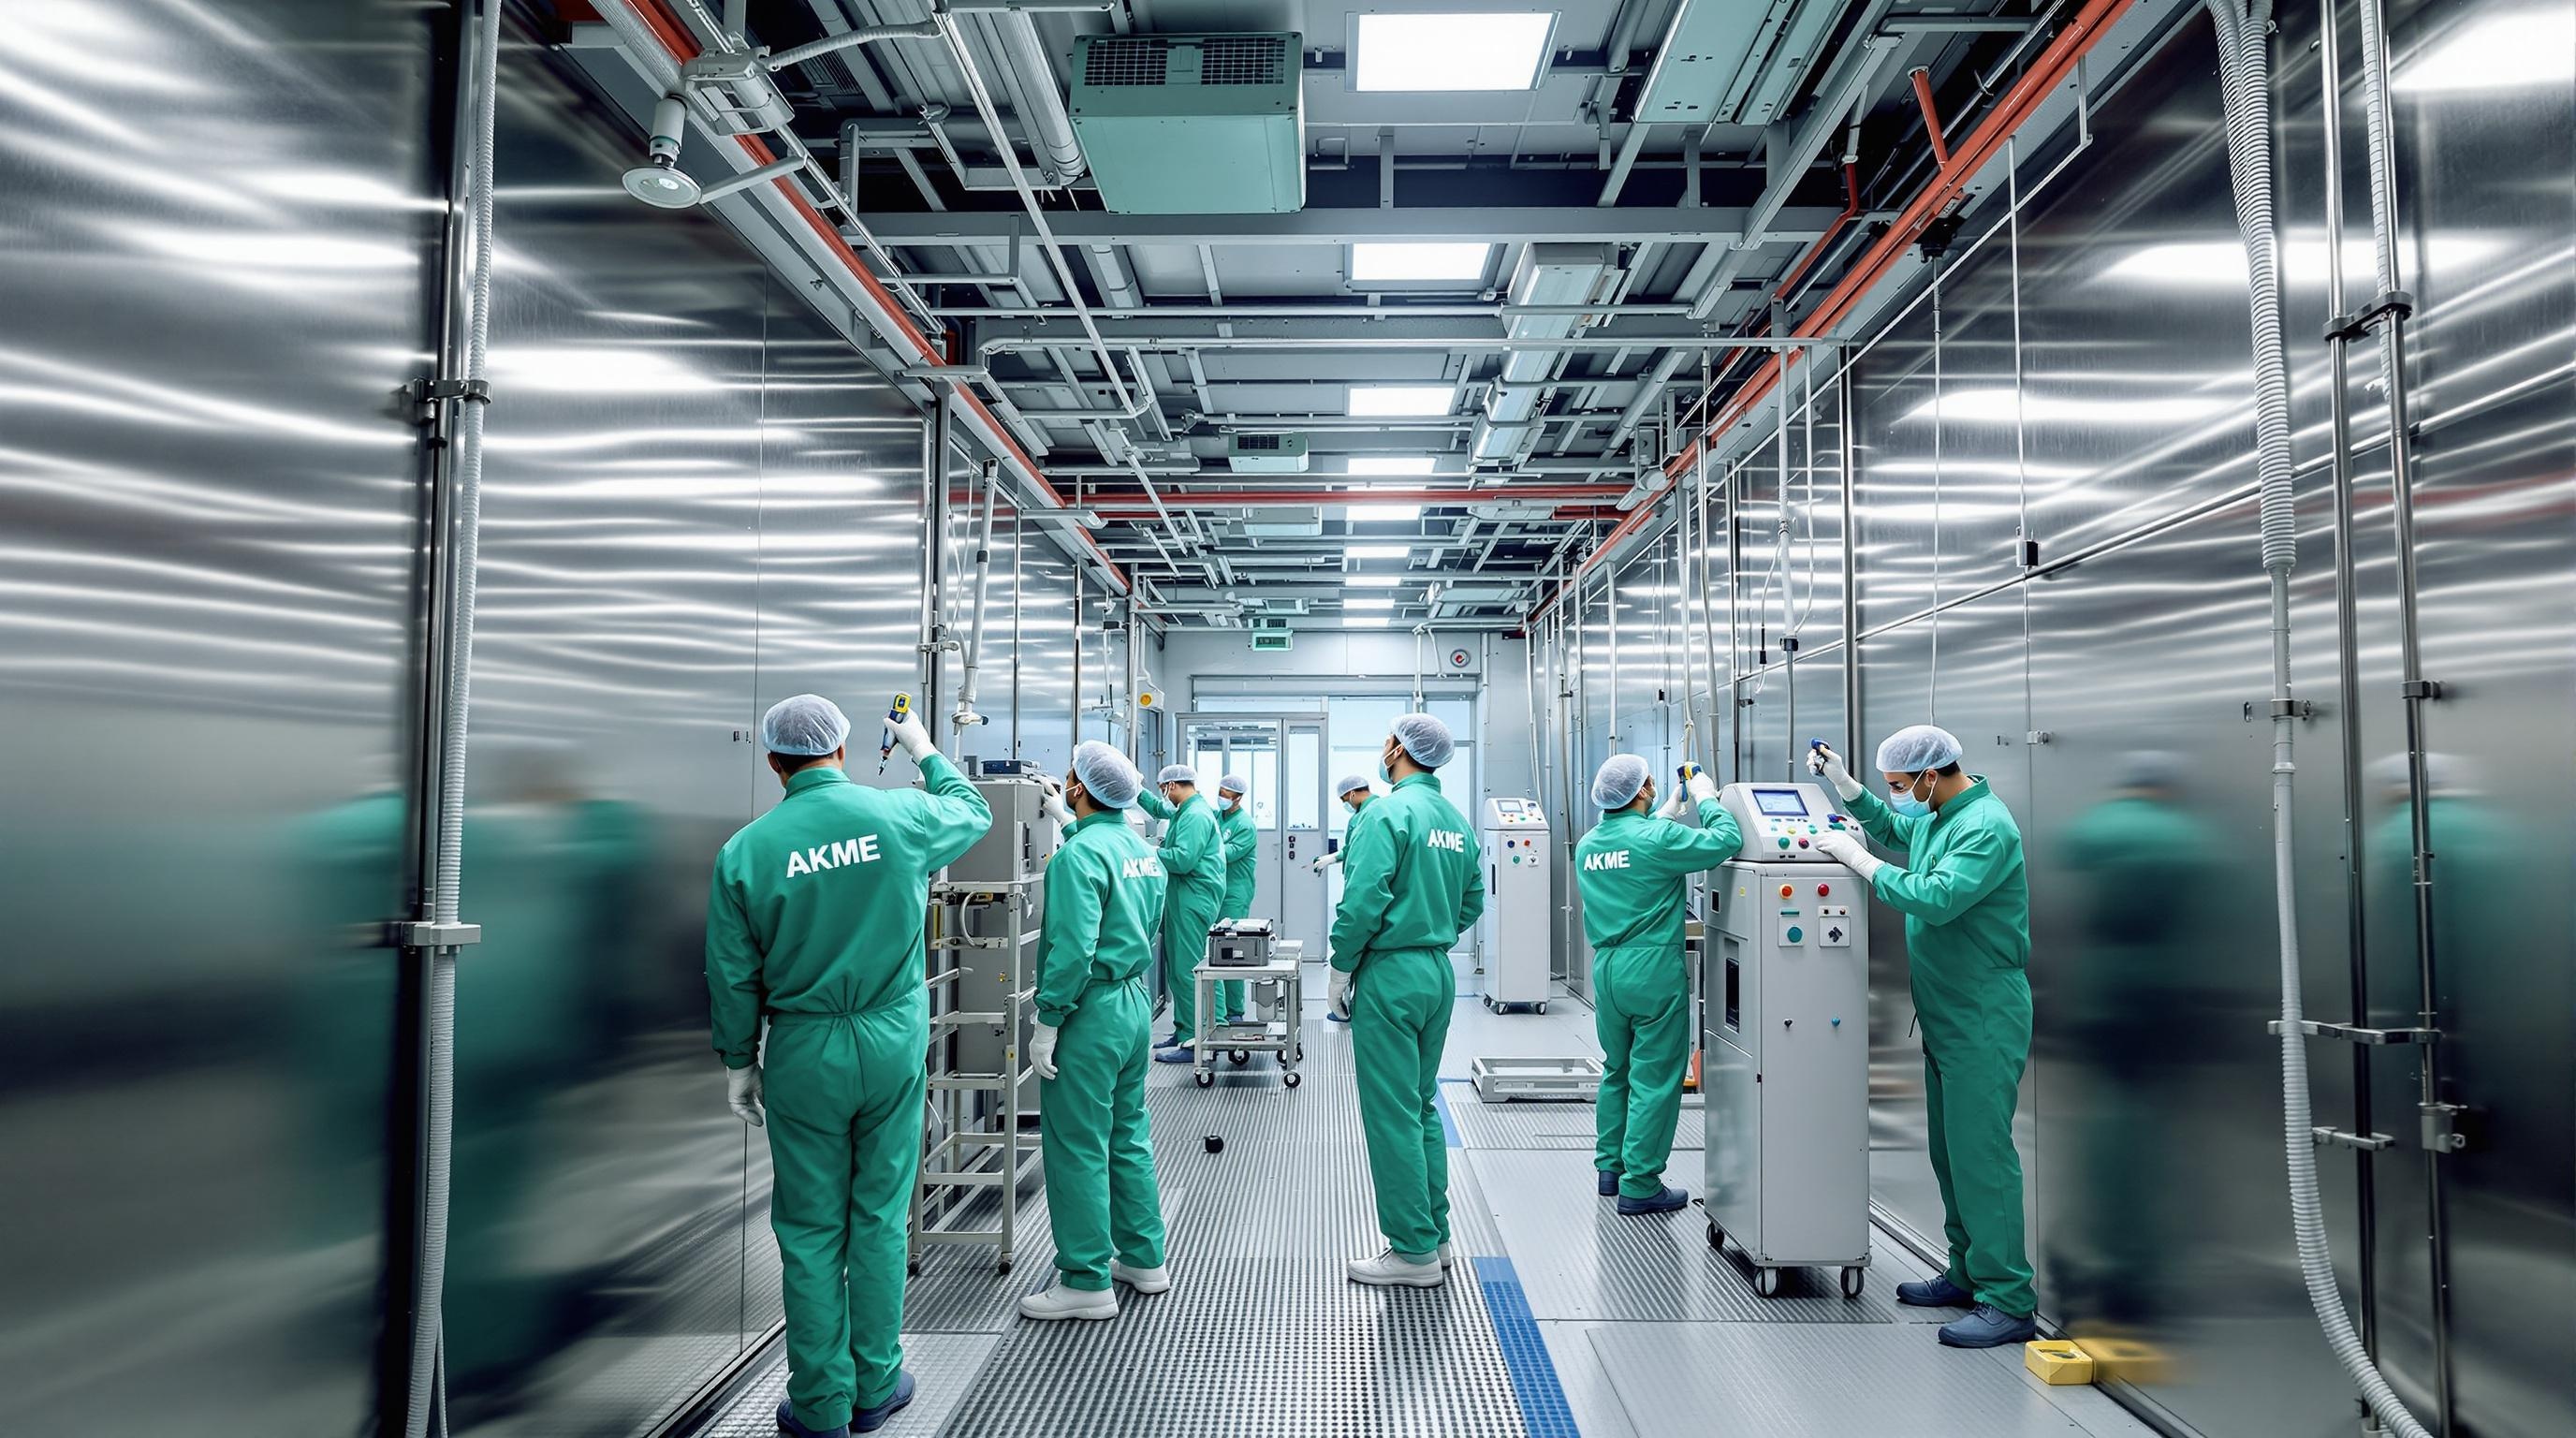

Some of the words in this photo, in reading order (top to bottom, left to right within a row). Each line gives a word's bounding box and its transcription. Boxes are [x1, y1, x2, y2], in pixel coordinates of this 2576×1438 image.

[1427, 829, 1464, 853] AKME
[786, 834, 881, 878] AKME
[1584, 850, 1631, 871] AKME
